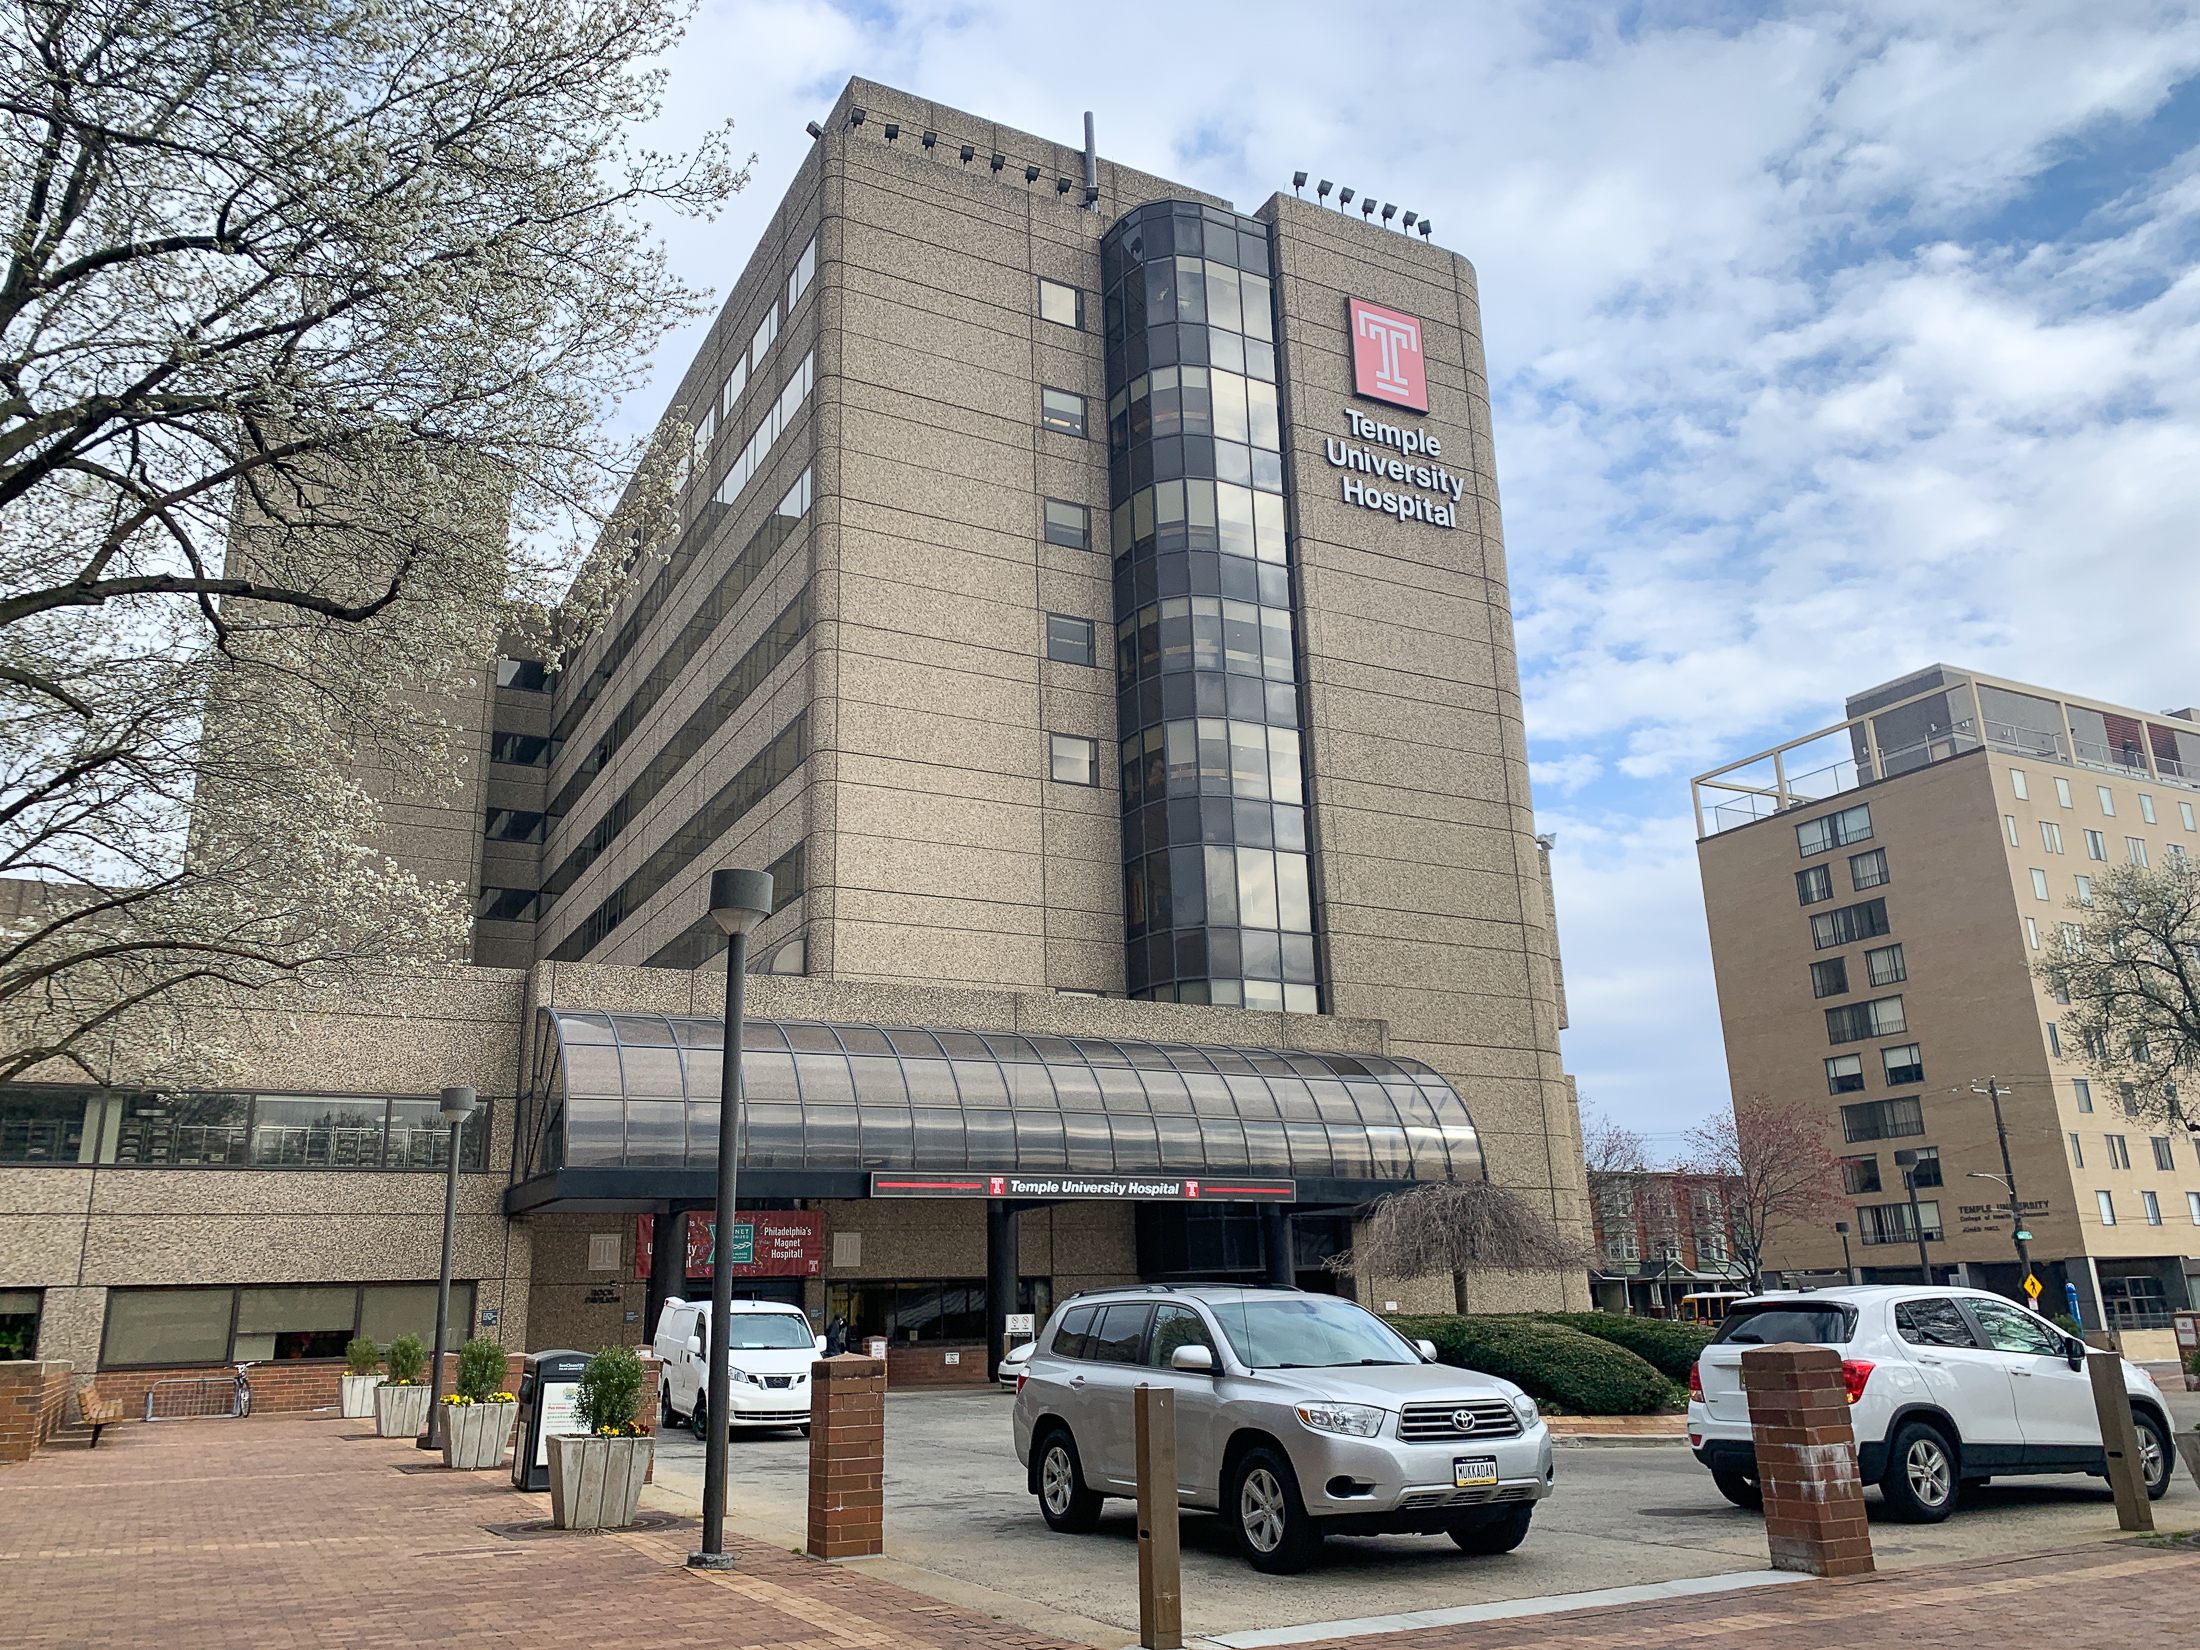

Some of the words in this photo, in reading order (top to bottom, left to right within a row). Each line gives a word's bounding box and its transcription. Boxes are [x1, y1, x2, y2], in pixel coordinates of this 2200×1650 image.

[1345, 408, 1442, 457] Temple
[1326, 438, 1465, 501] University
[1342, 476, 1457, 528] Hospital
[1011, 1180, 1060, 1195] Temple
[1062, 1180, 1125, 1196] University
[1128, 1182, 1180, 1196] Hospital
[1958, 1204, 1992, 1214] TEMPLE
[1997, 1200, 2049, 1211] UNIRSITY
[764, 1226, 812, 1238] Philadelphia's
[774, 1238, 801, 1250] Magnet
[771, 1248, 803, 1261] Hospital!
